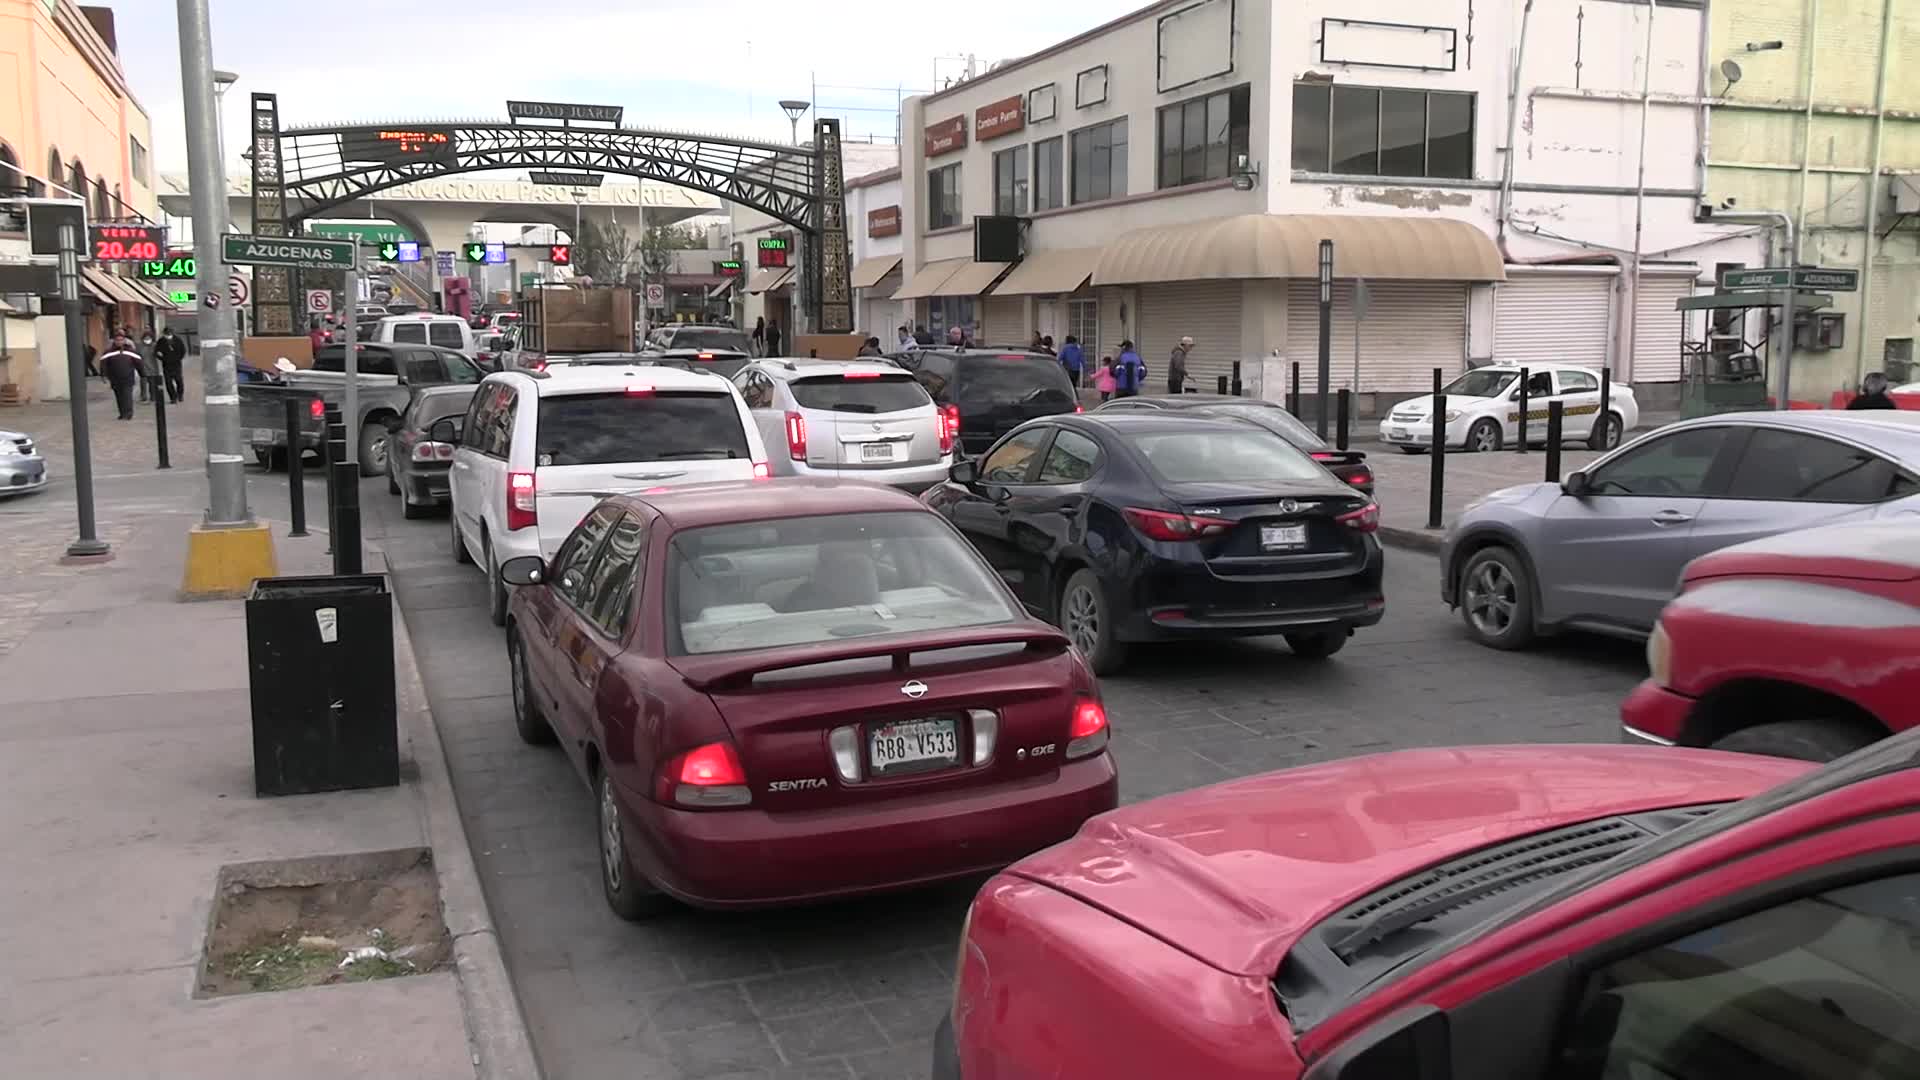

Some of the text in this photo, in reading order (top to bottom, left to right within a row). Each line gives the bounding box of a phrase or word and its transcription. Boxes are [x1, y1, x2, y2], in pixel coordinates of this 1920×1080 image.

[509, 103, 563, 117] CIUDAD
[613, 187, 673, 205] NORTE
[101, 229, 147, 238] VENTA
[96, 241, 158, 259] 20.40
[246, 244, 333, 260] AZUCENAS
[759, 240, 786, 249] COMPRA
[143, 258, 197, 276] 19.40
[916, 731, 956, 755] V533
[1031, 743, 1056, 757] GXE
[767, 777, 828, 792] SENTRA
